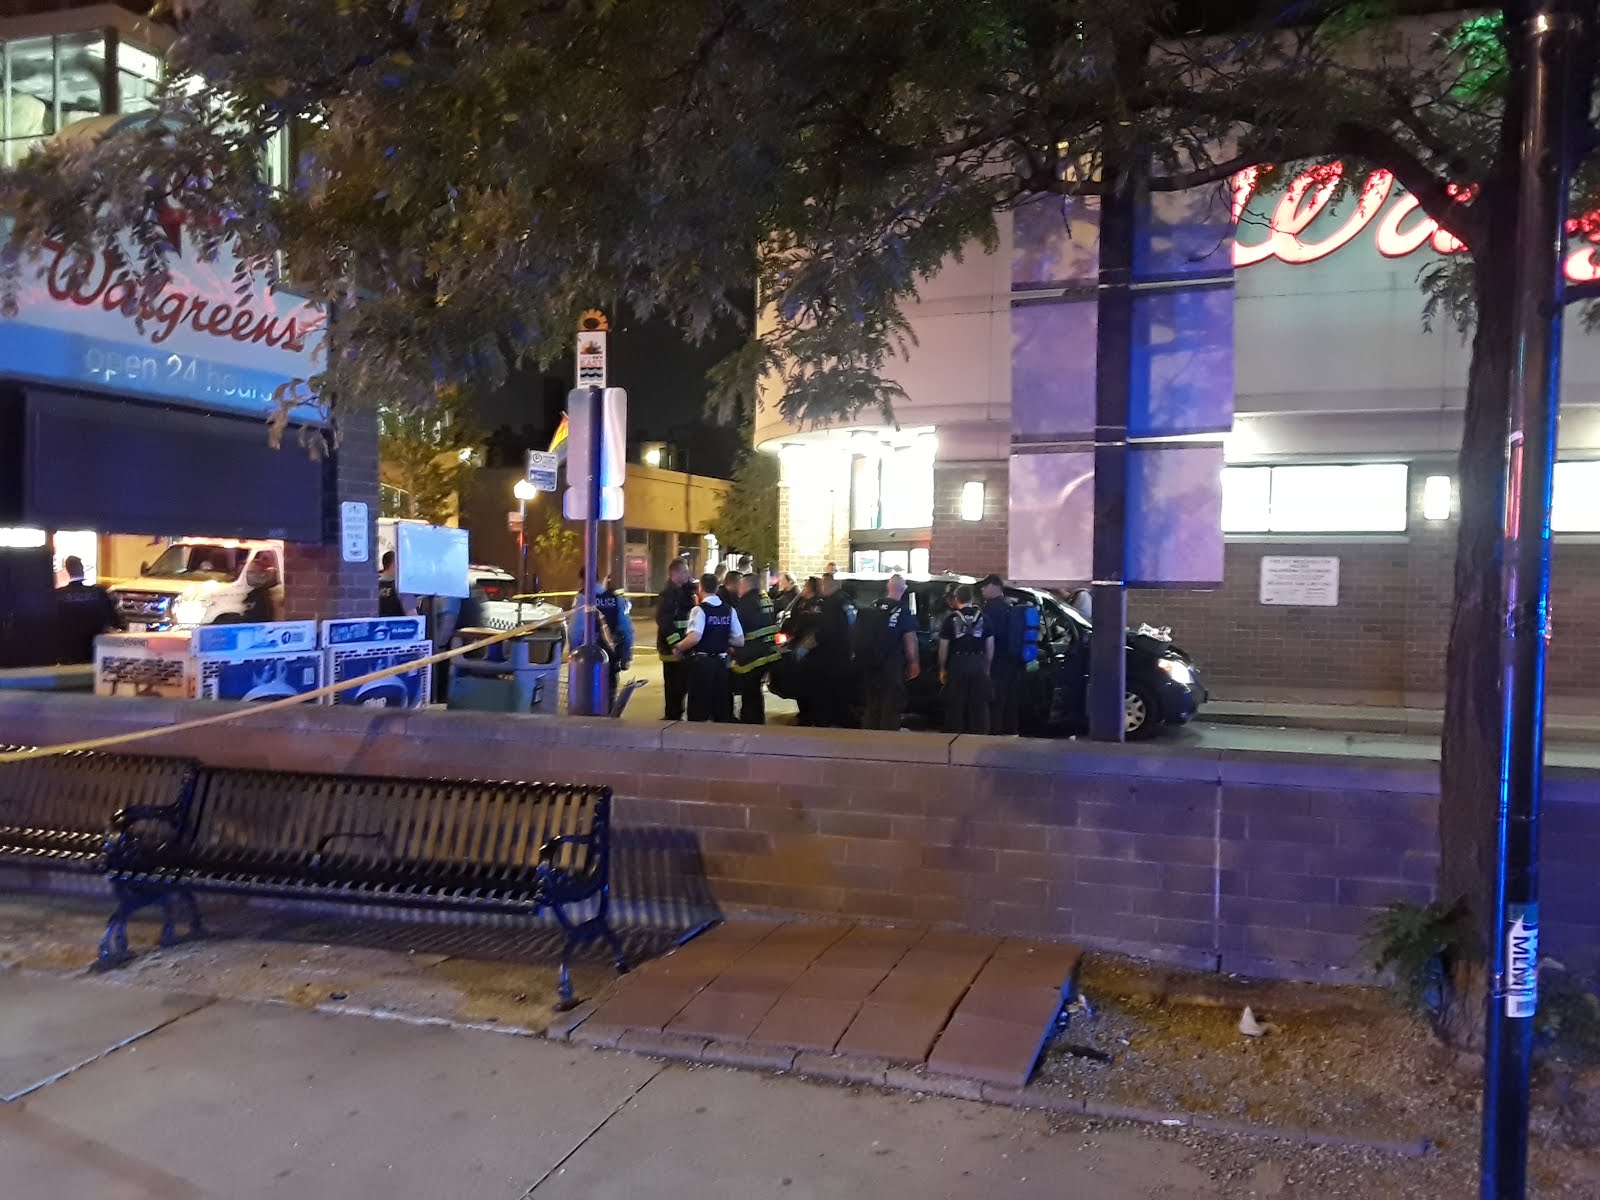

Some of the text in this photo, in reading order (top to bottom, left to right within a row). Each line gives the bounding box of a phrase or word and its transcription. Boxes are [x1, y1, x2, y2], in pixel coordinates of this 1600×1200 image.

[41, 239, 305, 352] Walgreens
[167, 353, 198, 383] 24
[595, 597, 617, 607] OLICE
[708, 615, 731, 625] POLICE
